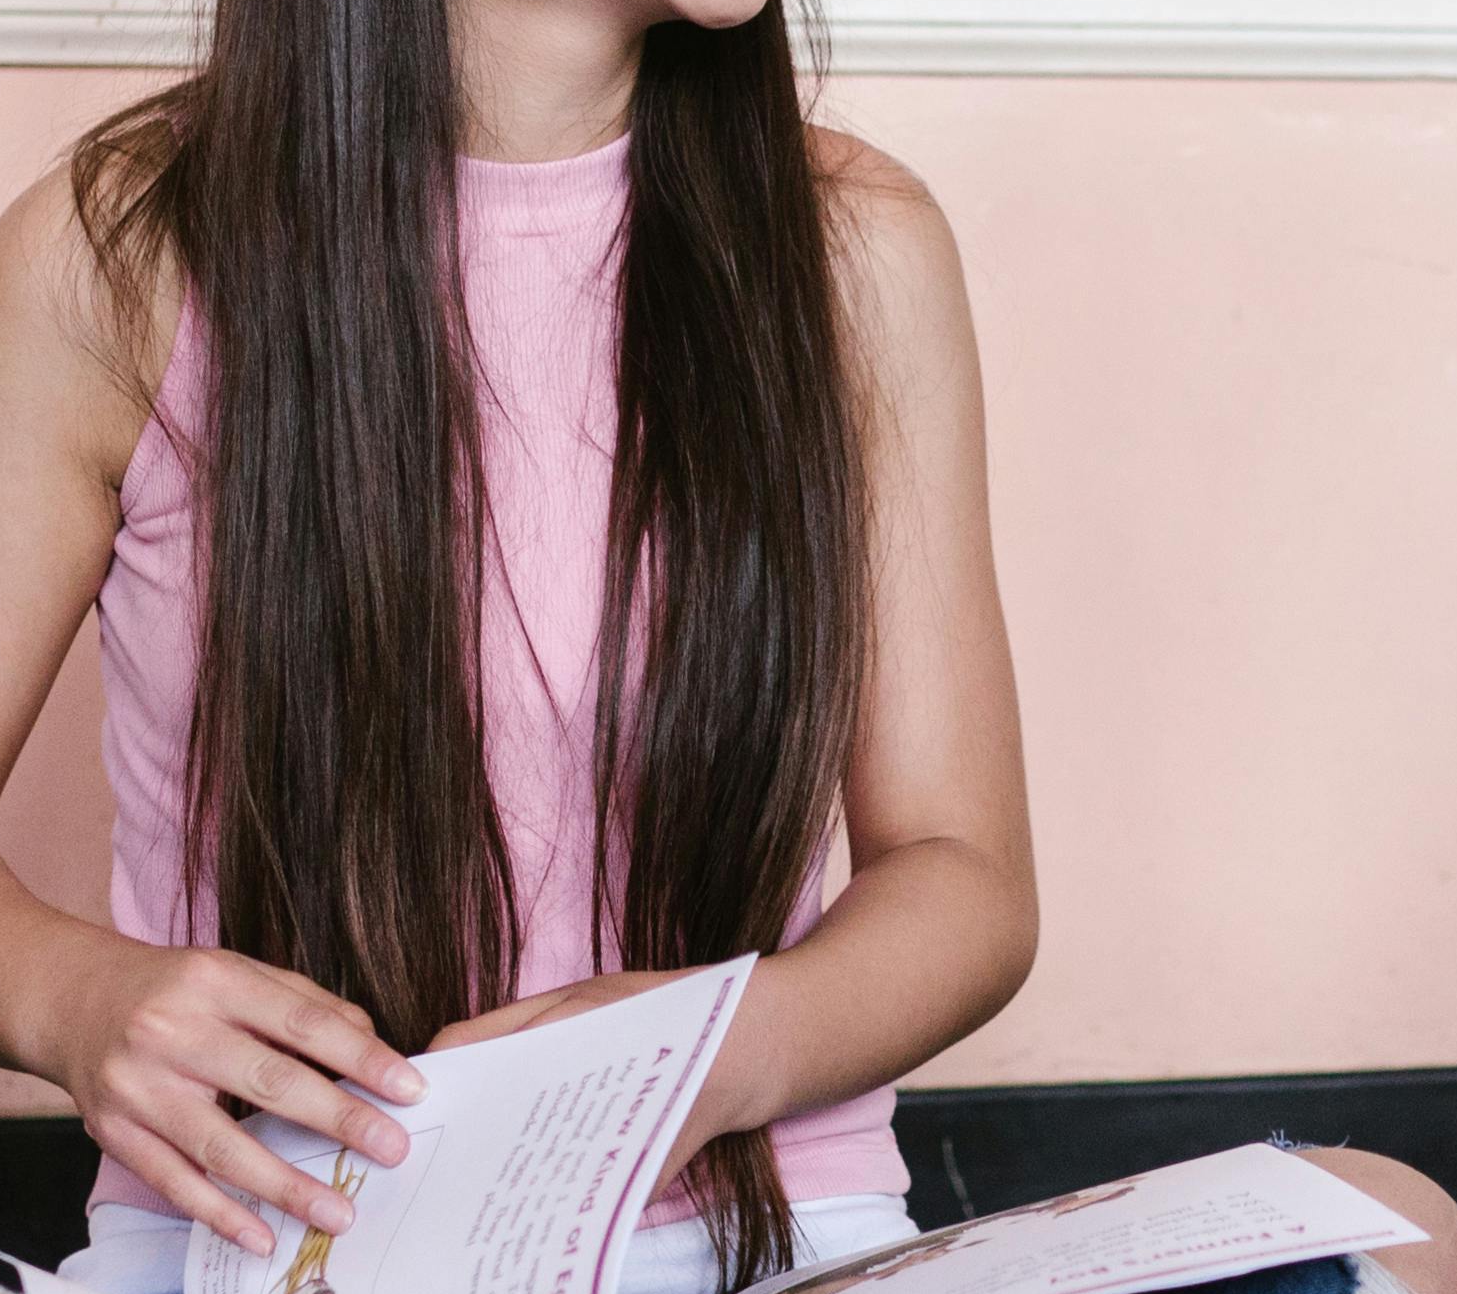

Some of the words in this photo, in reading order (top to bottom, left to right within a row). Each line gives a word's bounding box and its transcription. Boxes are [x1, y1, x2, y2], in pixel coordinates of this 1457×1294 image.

[652, 1047, 673, 1066] A
[617, 1074, 662, 1136] New
[577, 1146, 624, 1215] Kind
[562, 1226, 582, 1257] of
